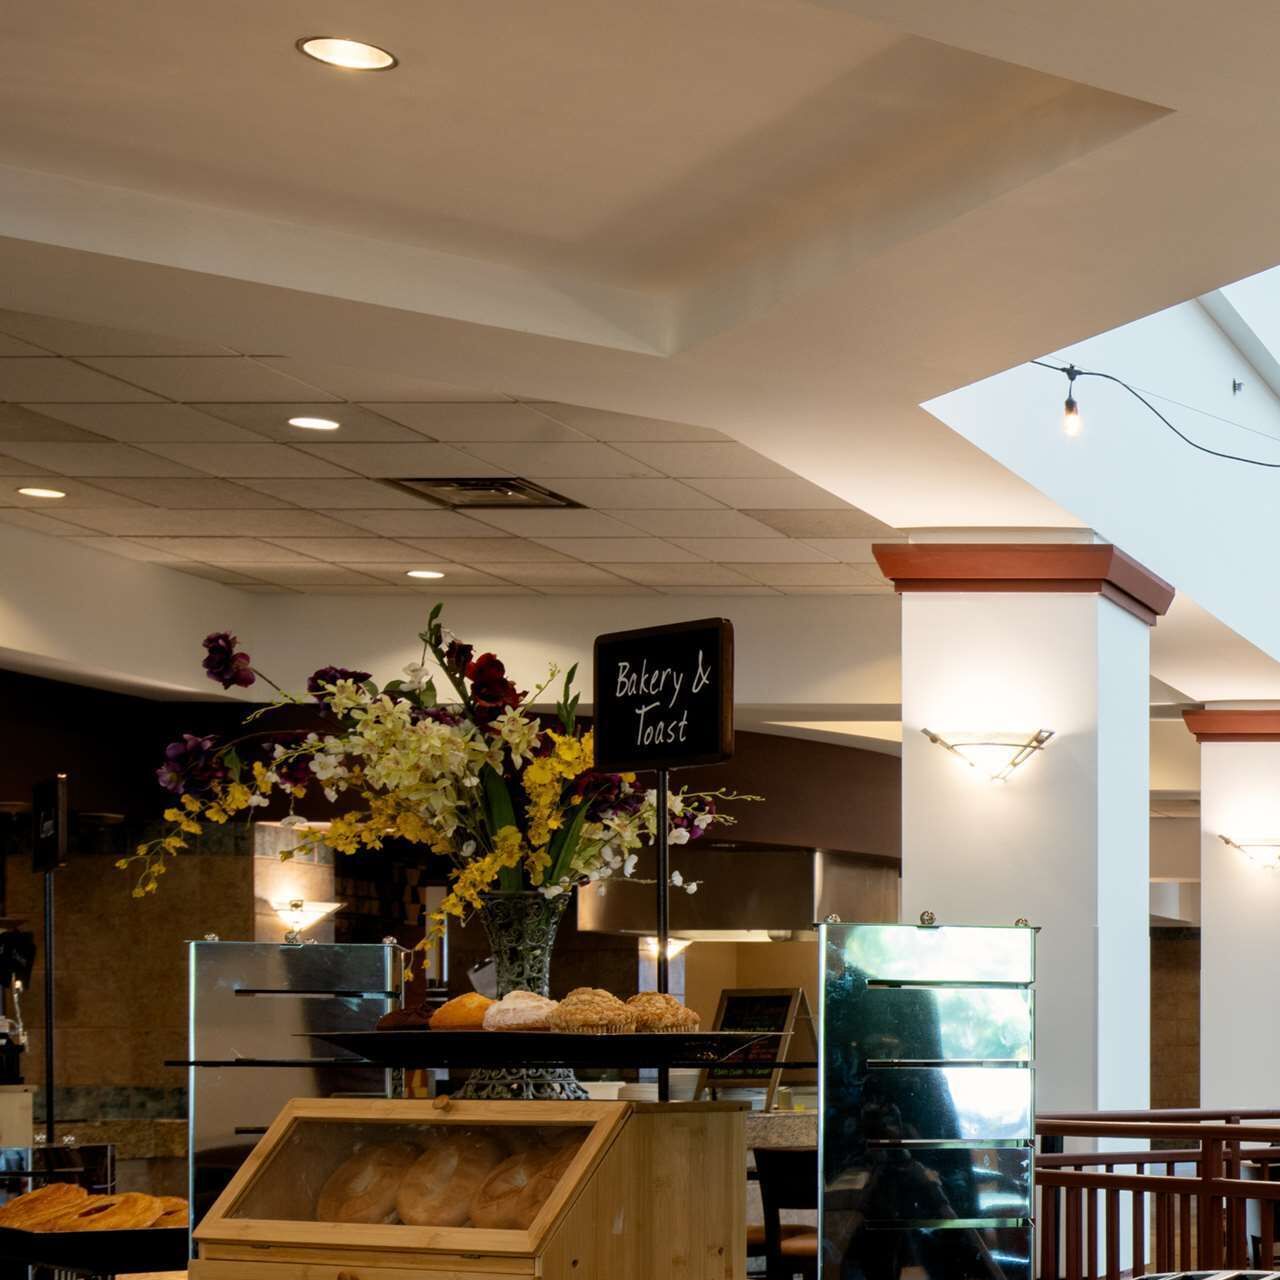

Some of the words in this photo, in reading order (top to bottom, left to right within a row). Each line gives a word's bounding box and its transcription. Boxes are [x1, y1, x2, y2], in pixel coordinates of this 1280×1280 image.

[616, 658, 683, 709] Bakery
[691, 649, 712, 693] &
[635, 701, 688, 745] Toast
